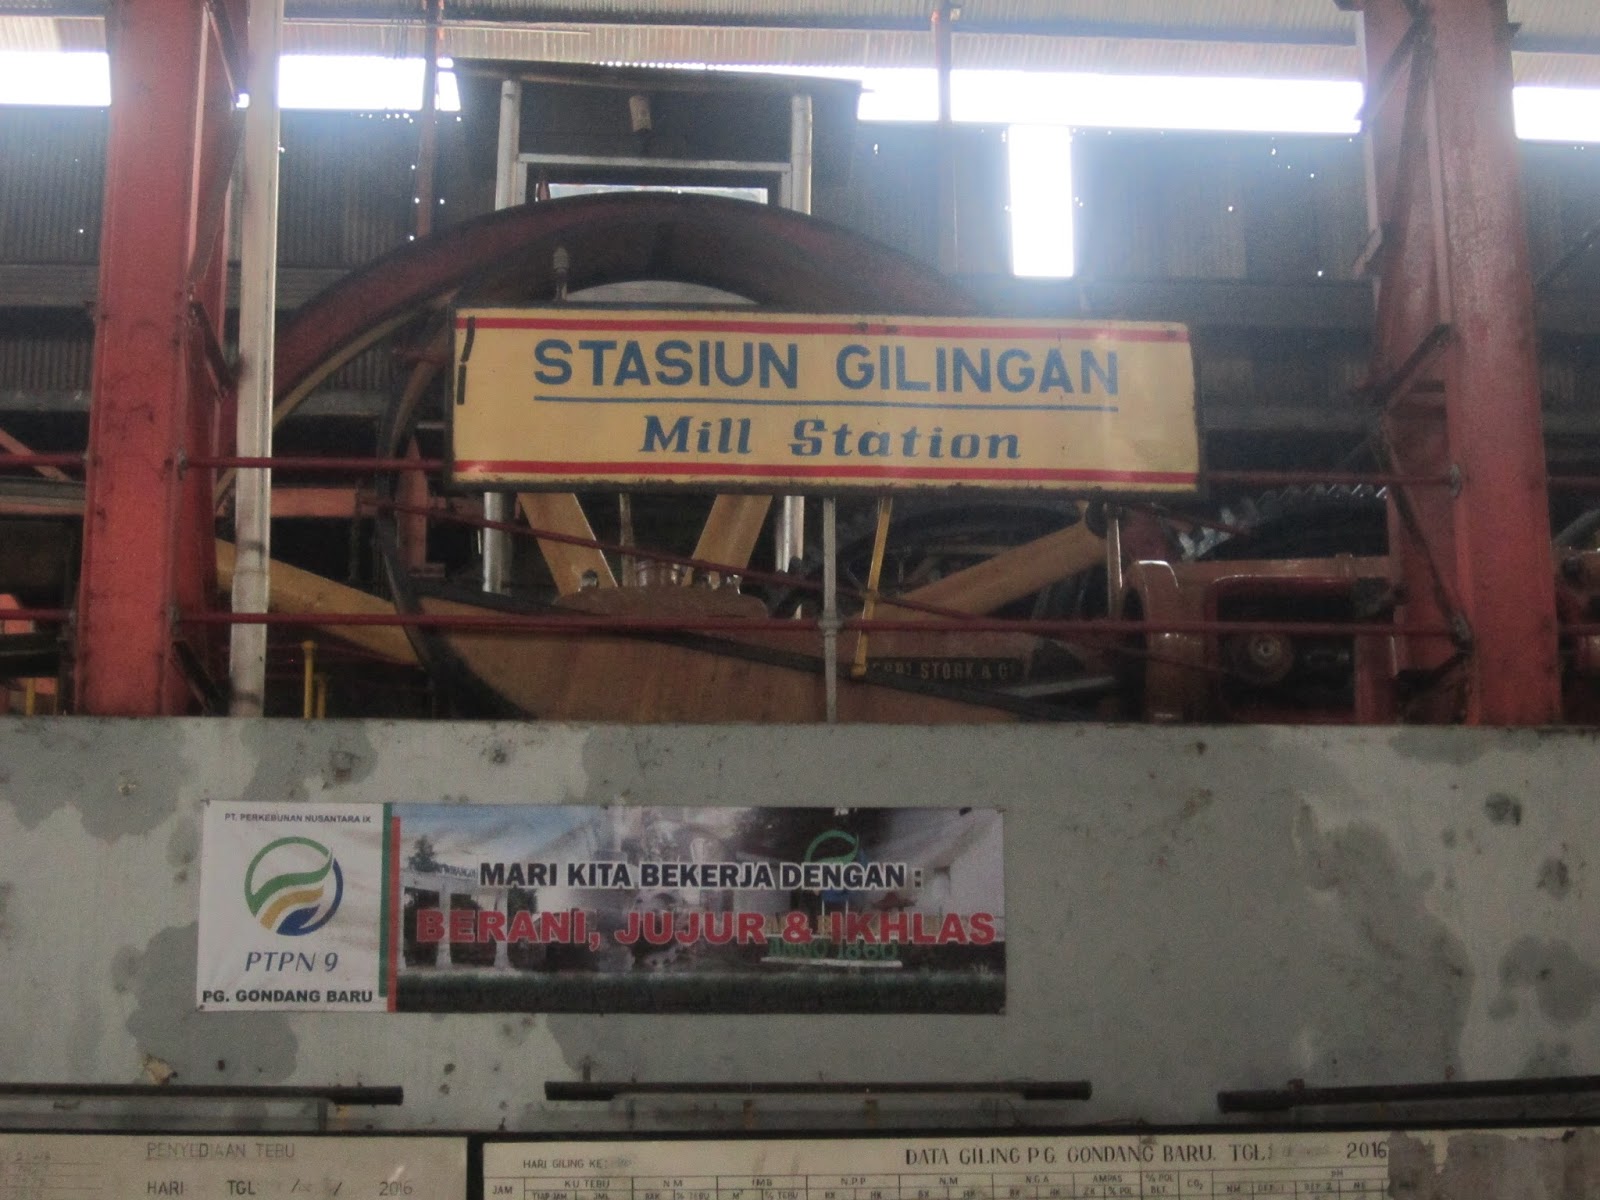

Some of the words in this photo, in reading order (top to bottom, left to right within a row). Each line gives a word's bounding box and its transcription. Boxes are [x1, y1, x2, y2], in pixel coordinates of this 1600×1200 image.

[534, 339, 798, 389] STASIUN
[836, 344, 1119, 395] GILINGAN
[638, 415, 752, 454] Mill
[788, 417, 1021, 459] Station
[920, 662, 974, 680] STORK
[225, 813, 237, 822] PT.
[240, 813, 303, 823] PERKEBUNAN
[305, 814, 360, 824] NUSANTARA
[362, 815, 371, 824] IX
[480, 862, 557, 887] MARI
[567, 862, 632, 888] KITA
[640, 863, 773, 888] BEKERJA
[781, 864, 905, 889] DENGAN
[416, 910, 600, 950] BERANI,
[614, 911, 767, 945] JUJUR
[782, 911, 812, 944] &
[830, 912, 996, 945] IKHLAS
[245, 951, 316, 972] PTPN
[325, 952, 339, 972] 9
[202, 989, 229, 1003] PG.
[235, 989, 323, 1003] GONDANG
[326, 990, 374, 1003] BARU
[255, 1143, 295, 1158] TEBU
[905, 1148, 949, 1165] DATA
[958, 1146, 1020, 1165] GILING
[1067, 1145, 1154, 1164] GONDANG
[1346, 1141, 1387, 1160] 2016
[523, 1159, 547, 1169] HARI
[552, 1158, 584, 1169] GILING
[147, 1180, 184, 1196] HARI
[227, 1179, 256, 1196] TGL
[492, 1185, 513, 1195] JAM
[585, 1179, 610, 1188] TEBU
